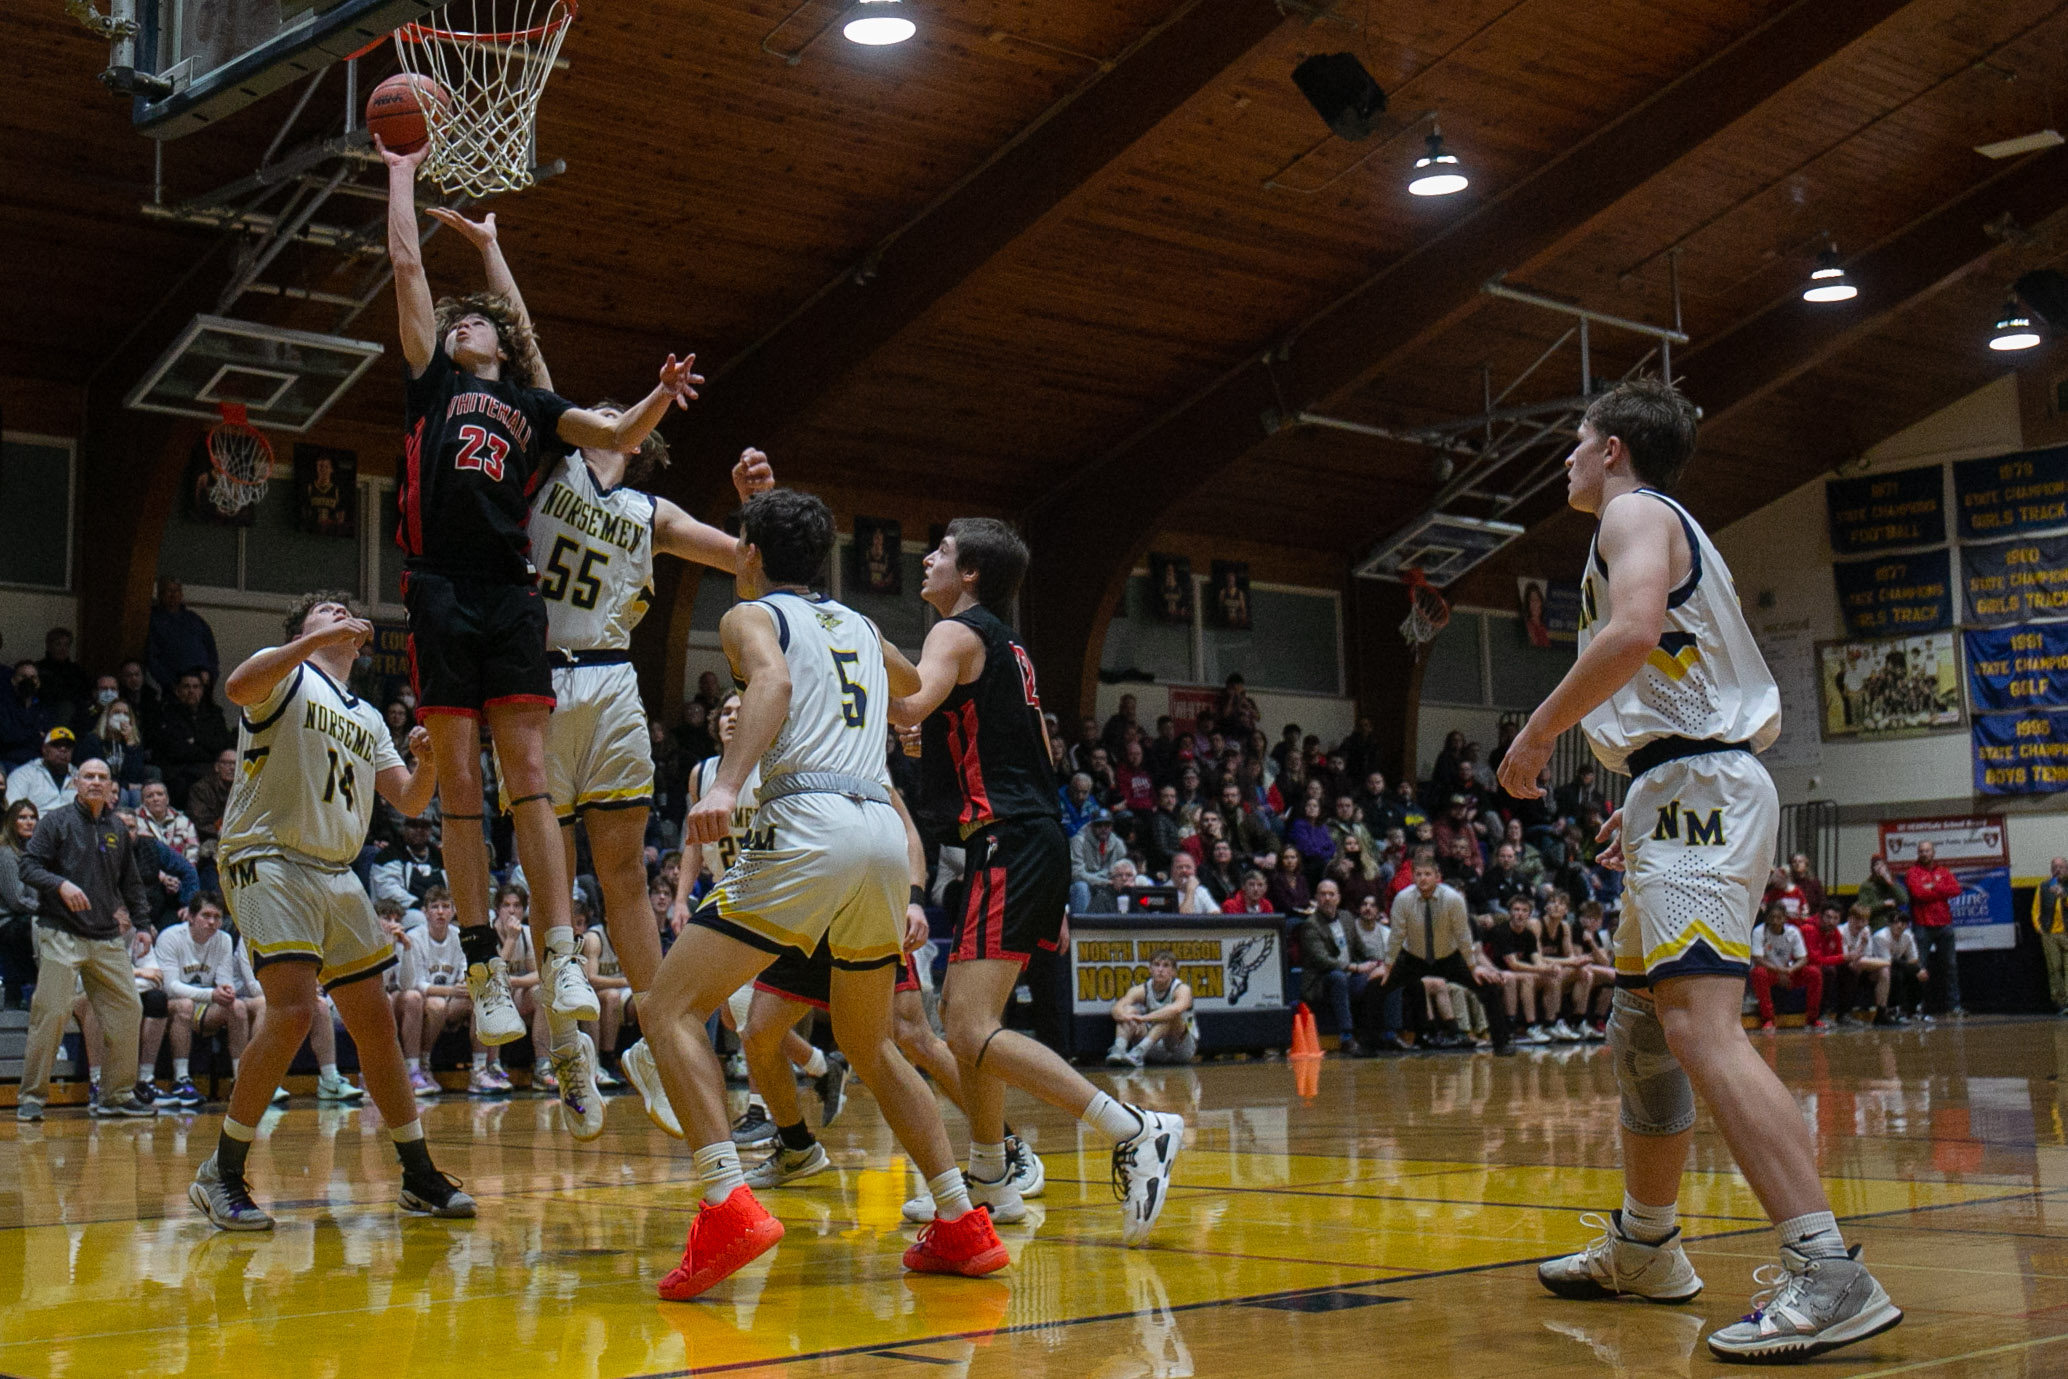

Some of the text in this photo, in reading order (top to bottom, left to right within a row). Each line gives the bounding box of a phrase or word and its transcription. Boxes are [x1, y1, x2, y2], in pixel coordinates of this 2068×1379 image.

[455, 424, 510, 482] 23
[541, 481, 645, 555] NORSEMEN
[2019, 502, 2066, 521] TRACK
[542, 533, 610, 611] 55
[1892, 604, 1939, 622] TRACK
[830, 646, 868, 729] 5
[2010, 678, 2049, 698] GOLF
[1979, 745, 2014, 760] STATE
[321, 747, 354, 813] 14
[1985, 767, 2026, 785] BOYS
[1077, 940, 1222, 962] NORTH MUSKEGON
[1077, 964, 1224, 1002] NORSMEN
